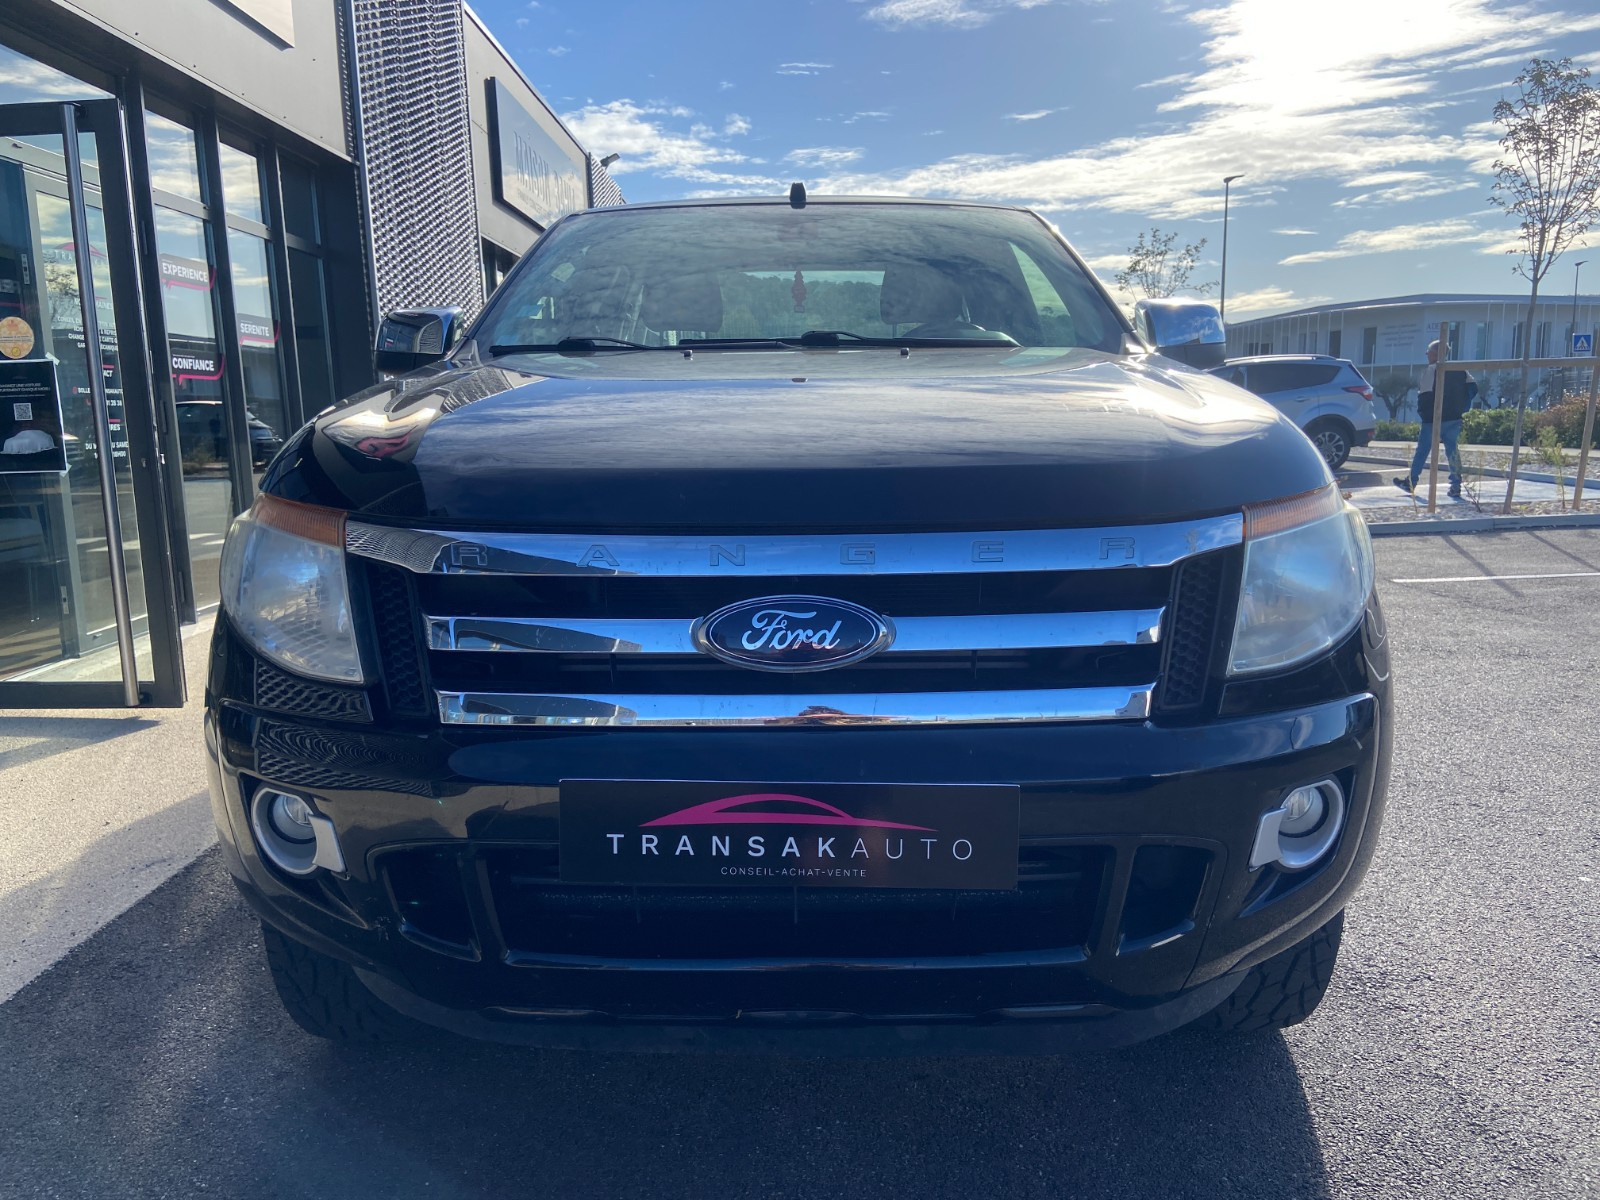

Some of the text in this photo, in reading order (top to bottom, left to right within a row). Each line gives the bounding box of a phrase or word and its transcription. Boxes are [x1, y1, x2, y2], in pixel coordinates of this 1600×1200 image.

[162, 262, 208, 282] EXPERIENCE
[240, 322, 270, 337] SERENITE
[172, 357, 215, 372] CONFIANCE
[451, 537, 1136, 567] RANGER
[741, 609, 842, 651] Ford
[606, 833, 973, 861] TRANSAKAUTO
[720, 866, 867, 878] CONSEIL-ACHAT-VENTE
